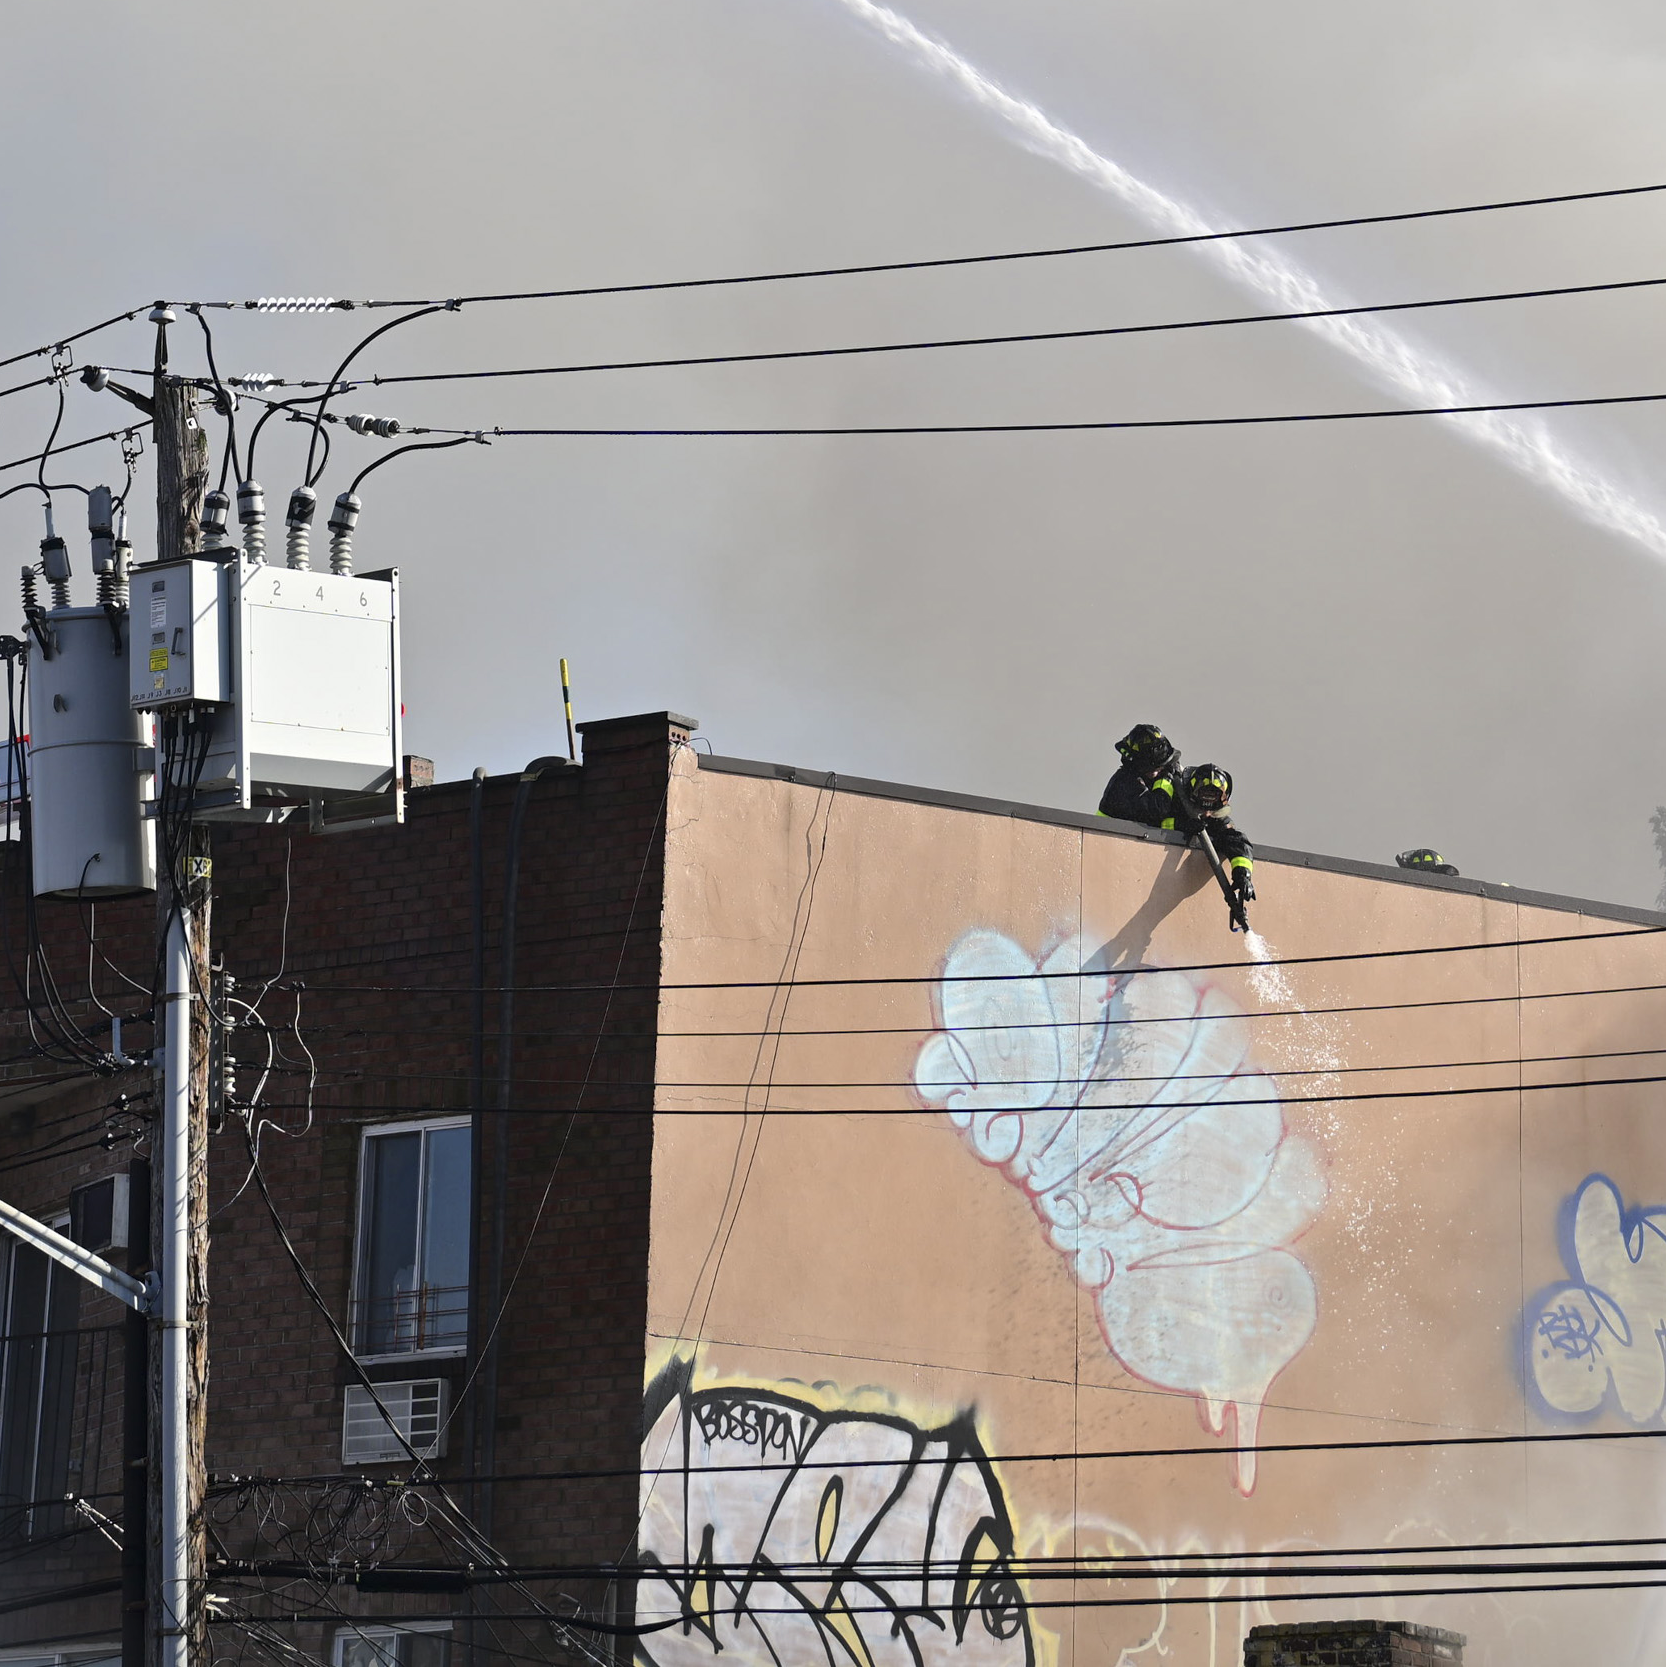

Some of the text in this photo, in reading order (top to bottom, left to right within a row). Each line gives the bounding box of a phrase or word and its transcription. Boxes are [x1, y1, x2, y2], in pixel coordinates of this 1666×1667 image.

[273, 580, 368, 607] 2 4 6
